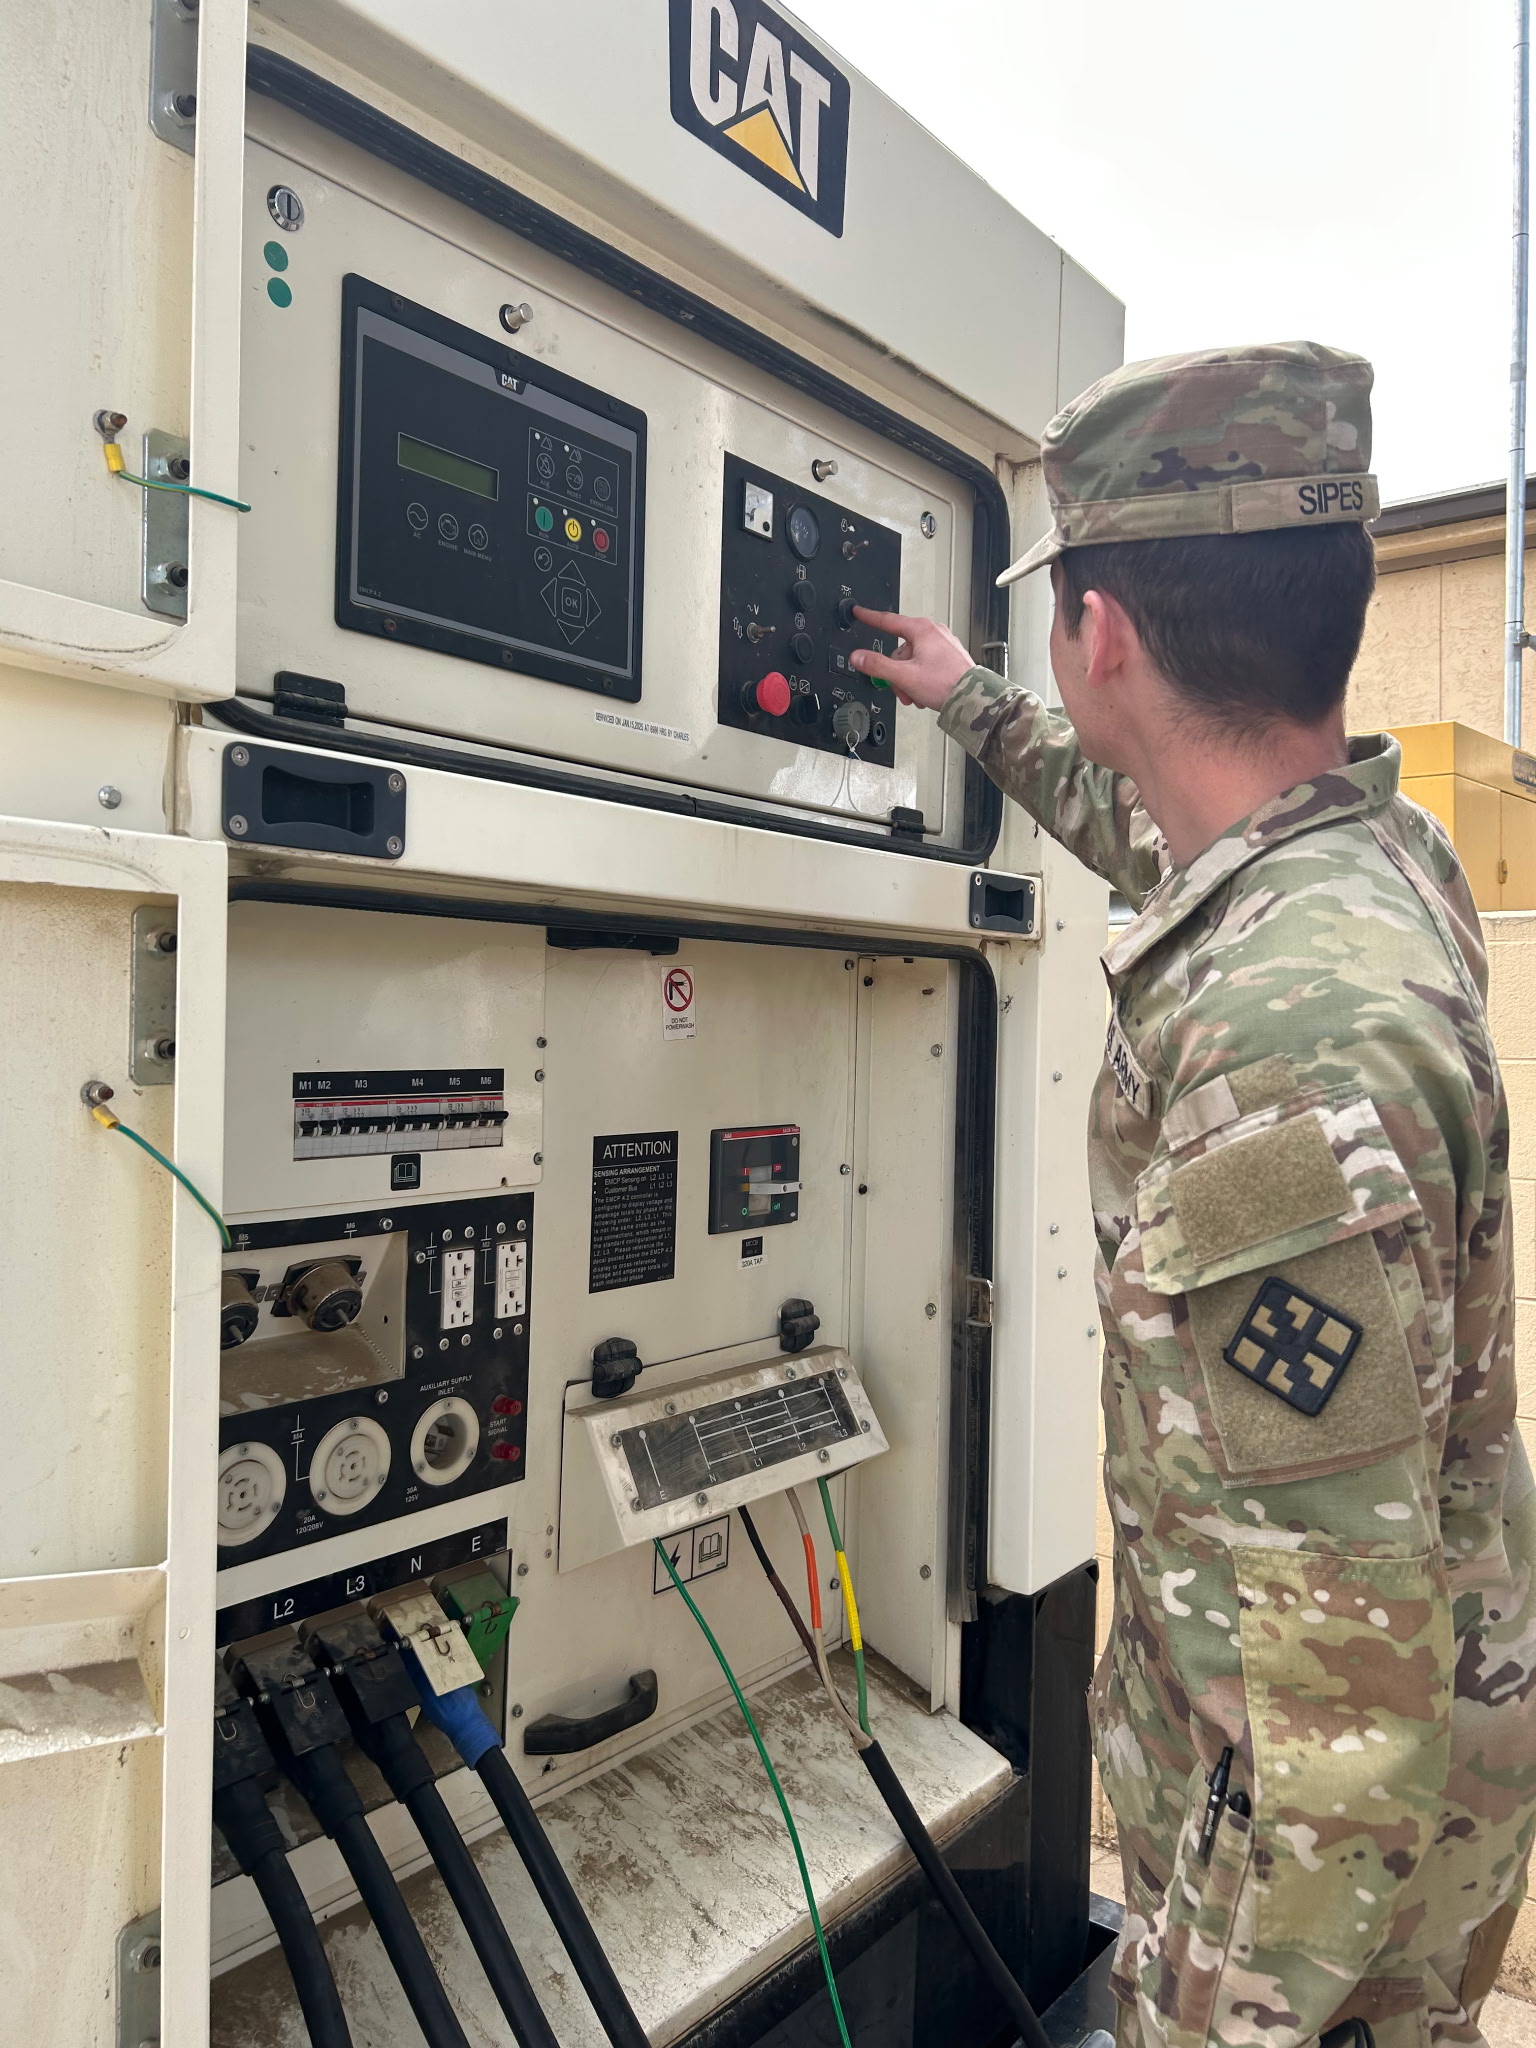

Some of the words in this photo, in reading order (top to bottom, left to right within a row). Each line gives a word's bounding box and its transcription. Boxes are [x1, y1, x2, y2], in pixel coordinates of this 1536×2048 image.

[689, 0, 831, 201] CAT
[501, 373, 518, 391] CAT
[566, 490, 582, 499] RESET
[1298, 481, 1364, 515] SIPES
[438, 540, 458, 552] ENGINE
[567, 542, 579, 550] AUTO
[464, 548, 476, 557] MAIN
[564, 596, 578, 609] OK
[595, 712, 614, 724] SERVICED
[615, 717, 621, 726] ON
[673, 731, 689, 741] CHARLES
[1112, 1044, 1140, 1104] ARMY
[300, 1081, 312, 1090] M1
[317, 1080, 331, 1090] M2
[355, 1080, 368, 1089] M3
[411, 1078, 424, 1087] M4
[450, 1078, 461, 1086] M5
[480, 1076, 492, 1085] M6
[603, 1140, 671, 1159] ATTENTION
[594, 1169, 618, 1178] SENSING
[619, 1166, 660, 1175] ARRANGEMENT
[754, 1257, 763, 1265] TAP
[420, 1380, 449, 1392] AUXILIARY
[451, 1375, 472, 1384] SUPPLY
[438, 1387, 454, 1396] INLET
[489, 1418, 507, 1428] START
[488, 1426, 508, 1436] SIGNAL
[840, 1429, 848, 1438] L3
[798, 1442, 807, 1451] L2
[754, 1458, 763, 1467] L1
[709, 1474, 717, 1482] N
[407, 1486, 417, 1495] 30A
[660, 1490, 667, 1499] E
[405, 1494, 419, 1503] 125V
[303, 1515, 316, 1523] 20A
[296, 1521, 324, 1534] 120/208V
[274, 1598, 294, 1620] L2
[346, 1575, 365, 1595] L3
[411, 1555, 422, 1573] N
[472, 1536, 481, 1552] E
